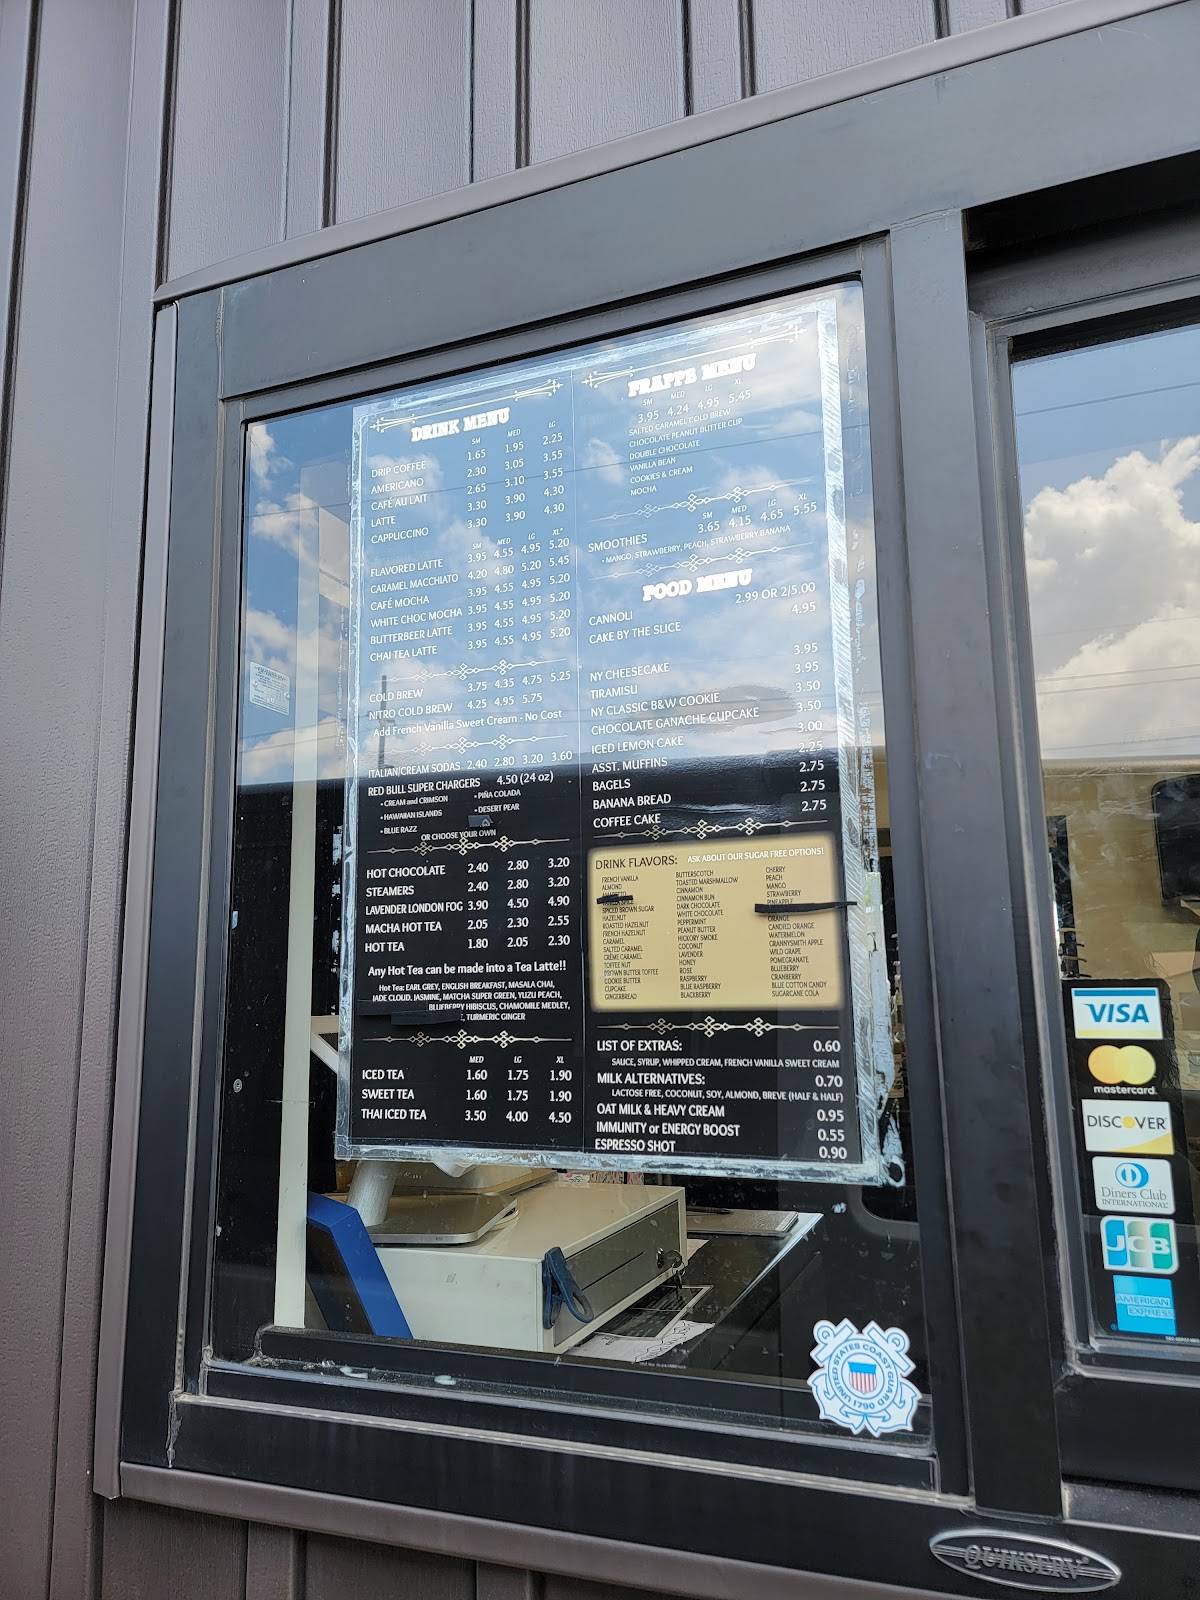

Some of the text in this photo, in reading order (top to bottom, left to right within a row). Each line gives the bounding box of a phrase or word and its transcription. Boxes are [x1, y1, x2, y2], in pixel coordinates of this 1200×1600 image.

[411, 408, 510, 442] DRINK MENU
[629, 409, 730, 436] SALTED CARAMEL COLD BREW
[508, 429, 520, 437] MED
[372, 433, 562, 478] DRIP COFFEE 1.65 1.95 2.25
[630, 440, 700, 460] DOUBLE CHOCOLATE
[371, 451, 562, 494] AMERICANO 2.30 3.05 3.55
[630, 486, 656, 496] MOCHA
[371, 516, 396, 527] LATTE
[588, 503, 817, 553] SMOOTHIES 3.65 4.15 4.65 5.55
[371, 528, 428, 543] CAPPUCCINO
[371, 539, 569, 577] FLAVORED LATTE 3.95 4.55 4.95 5.20
[371, 574, 458, 594] CARAMEL MACCHIATO
[643, 569, 752, 601] FOOD MENU
[589, 582, 815, 626] CANNOLI 2.99 OR 2/5.00
[371, 608, 462, 628] WHITE CHOC MOCHA
[371, 626, 452, 645] BUTTERBEER LATTE
[589, 622, 681, 644] CAKE BY THE SLICE
[370, 671, 570, 703] COLD BREW 3.75 4.35 4.75 5.25
[591, 685, 638, 699] TIRAMISU
[374, 709, 562, 737] Add French Vanilla Sweet Cream No Cost
[591, 708, 759, 736] CHOCOLATE GANACHE CUPCAKE
[368, 775, 517, 796] RED BULL SUPER CHARGERS 4.50
[478, 789, 521, 799] PIÑA COLADA
[593, 794, 827, 812] BANANA BREAD 2.75
[367, 857, 569, 879] HOT CHOCOLATE 2.40 2.80 3.20
[596, 856, 678, 870] DRINK FLAVORS:
[366, 886, 414, 897] STEAMERS
[365, 896, 569, 915] LAVENDER LONDON FOG 3.90 4.50 4.90
[368, 960, 566, 978] Any Hot Tea can be made into a Tea Latte!!
[1085, 1003, 1149, 1023] VISA
[597, 1040, 840, 1052] LIST OF EXTRAS: 0.60
[724, 1058, 839, 1068] FRENCH VANILLA SWEET CREAM
[362, 1070, 572, 1081] ICED TEA 1.60 1.75 1.90
[598, 1073, 705, 1085] MILK ALTERNATIVES:
[361, 1109, 426, 1120] THAI ICED TEA
[1088, 1115, 1166, 1130] DISCOVER
[597, 1122, 845, 1141] IMMUNITY or ENERGY BOOST 0.55
[1101, 1186, 1166, 1201] Diners Club
[1102, 1199, 1168, 1208] INTERNATIONAL
[1107, 1234, 1170, 1254] JCB
[832, 1343, 894, 1406] UNITED STATES COAST GUARD
[853, 1400, 875, 1409] 1790
